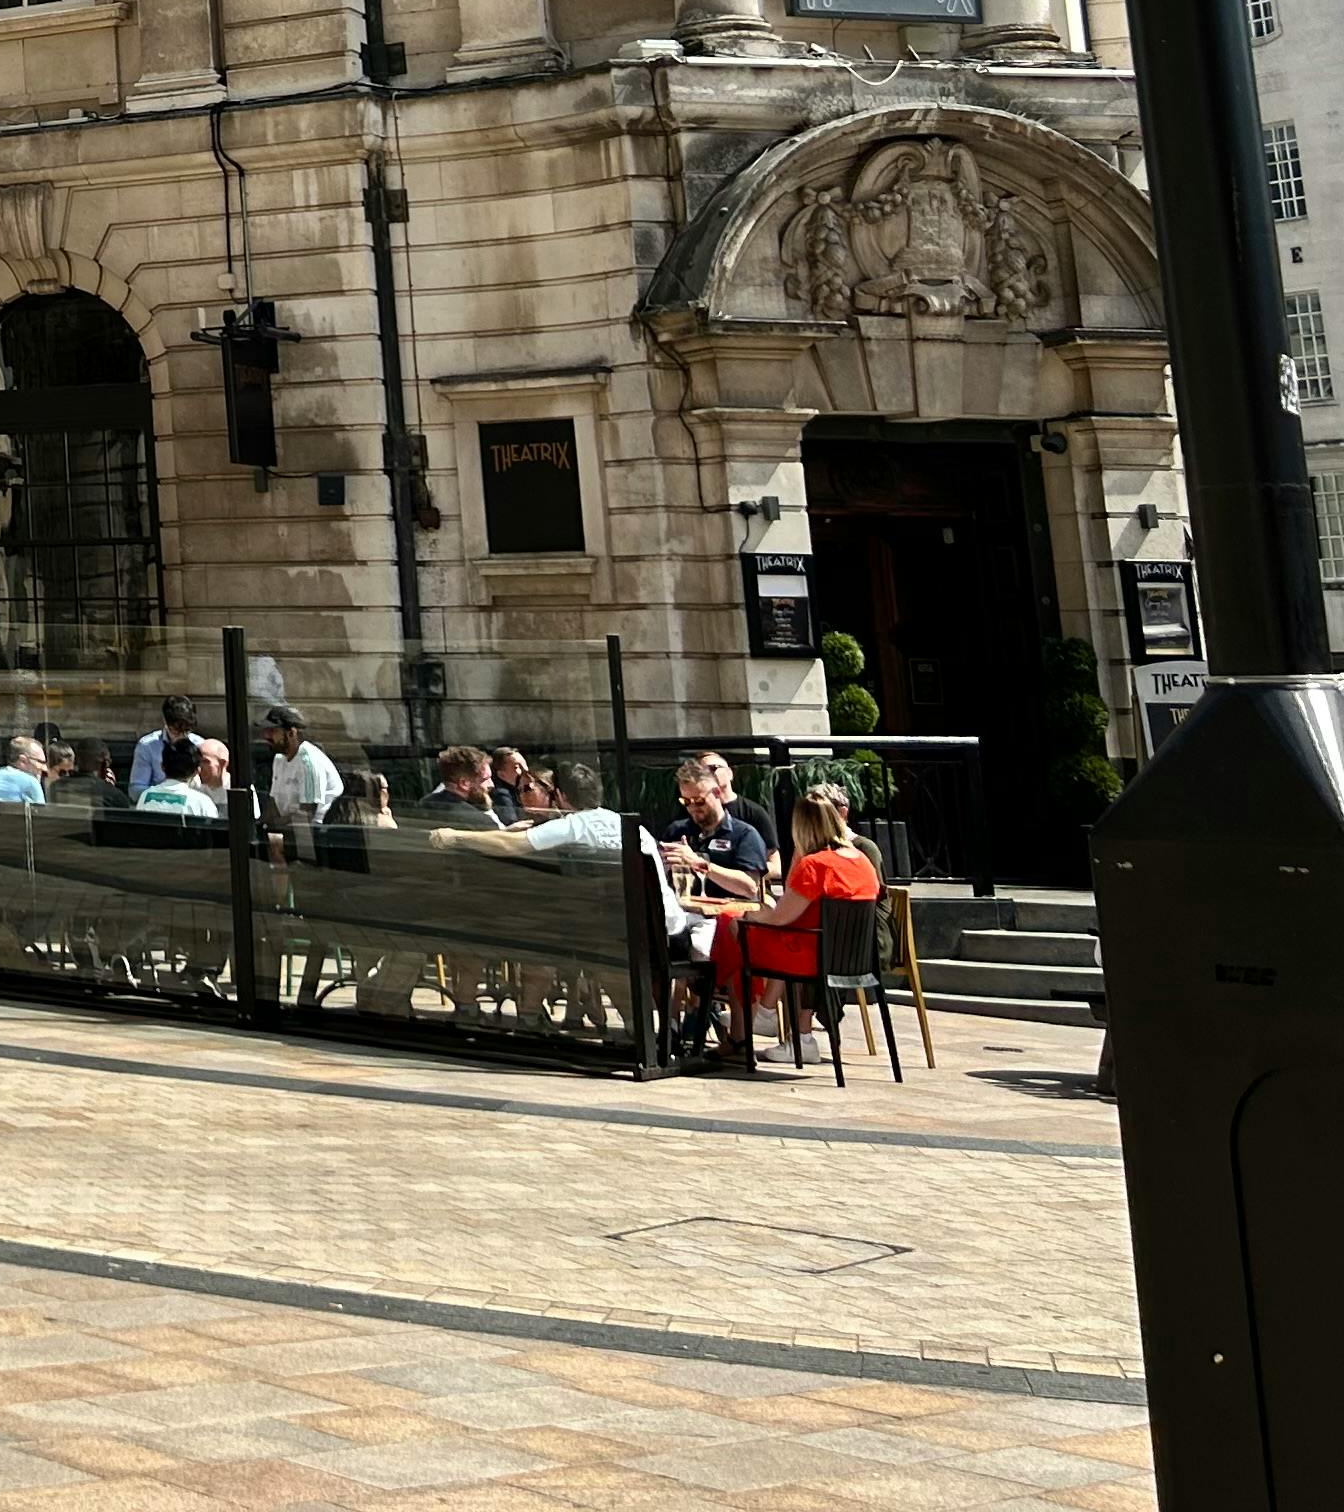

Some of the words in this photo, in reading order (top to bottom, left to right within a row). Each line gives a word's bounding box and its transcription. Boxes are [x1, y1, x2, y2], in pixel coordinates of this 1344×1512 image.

[1290, 247, 1303, 263] E
[490, 440, 571, 472] THEATRIX
[755, 555, 807, 572] THEATRIX
[1134, 563, 1184, 580] THEATRIX
